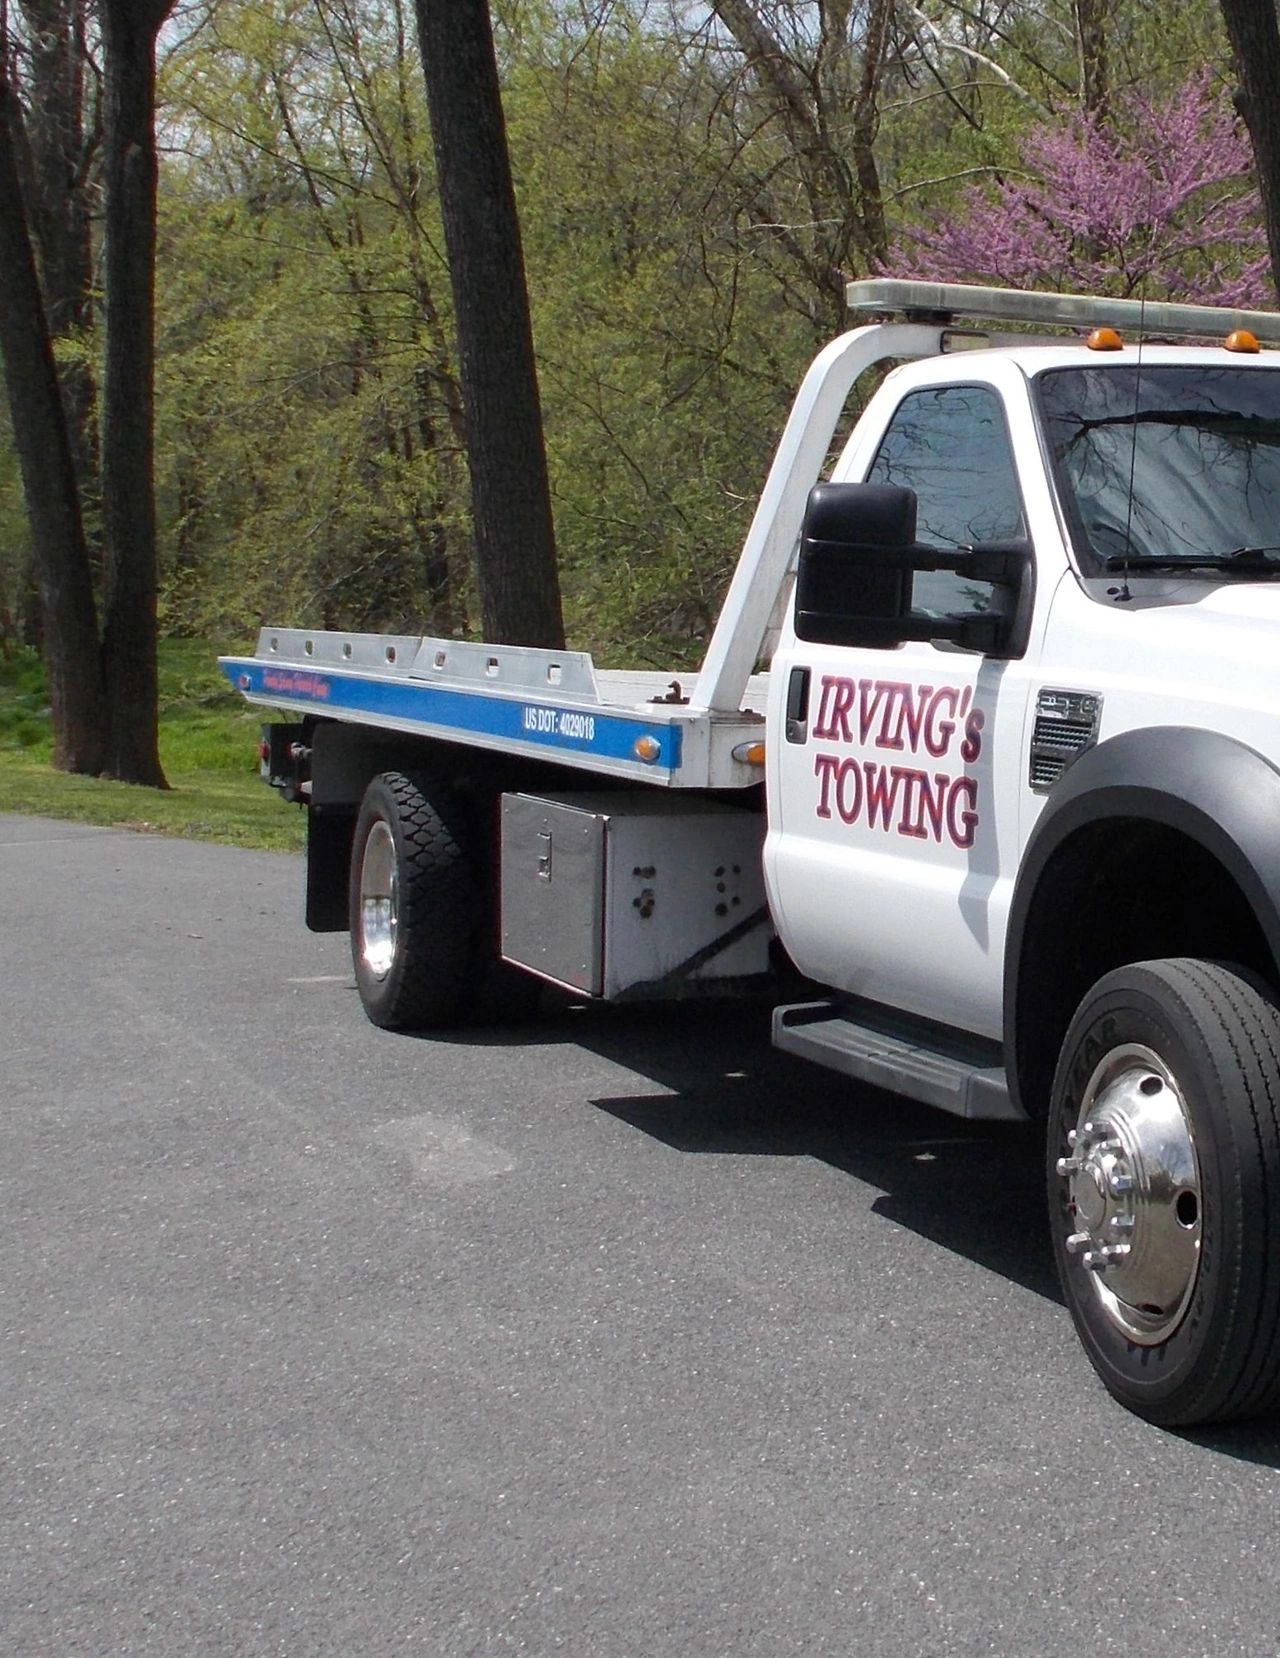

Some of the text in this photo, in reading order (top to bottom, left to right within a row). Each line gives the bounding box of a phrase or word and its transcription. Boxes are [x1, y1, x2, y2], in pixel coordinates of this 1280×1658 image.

[525, 707, 595, 740] US DOT: 4029018
[814, 752, 979, 849] TOWING
